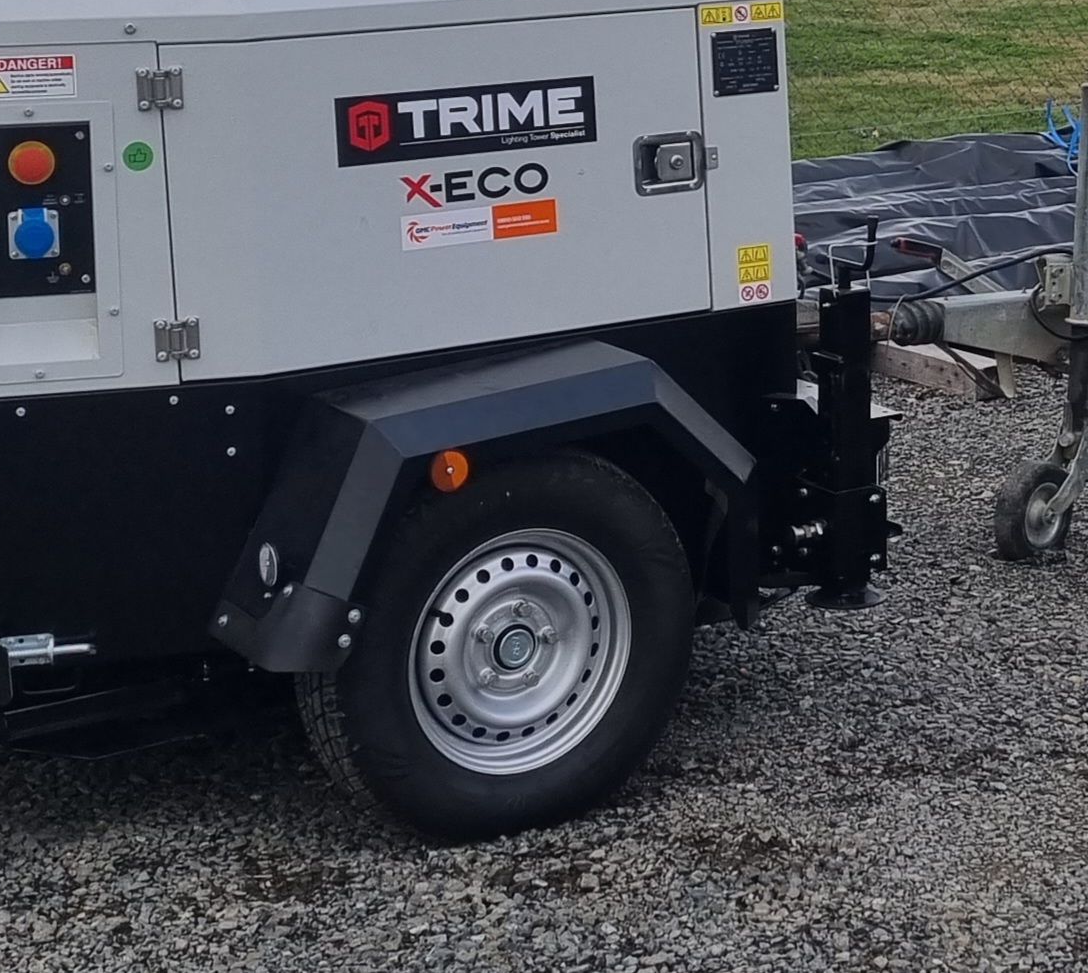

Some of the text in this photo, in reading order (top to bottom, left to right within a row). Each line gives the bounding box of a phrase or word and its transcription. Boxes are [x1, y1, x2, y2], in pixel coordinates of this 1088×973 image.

[397, 86, 585, 139] TRIME
[501, 129, 586, 145] Lighting Tower Specialist
[399, 163, 549, 208] X-ECO
